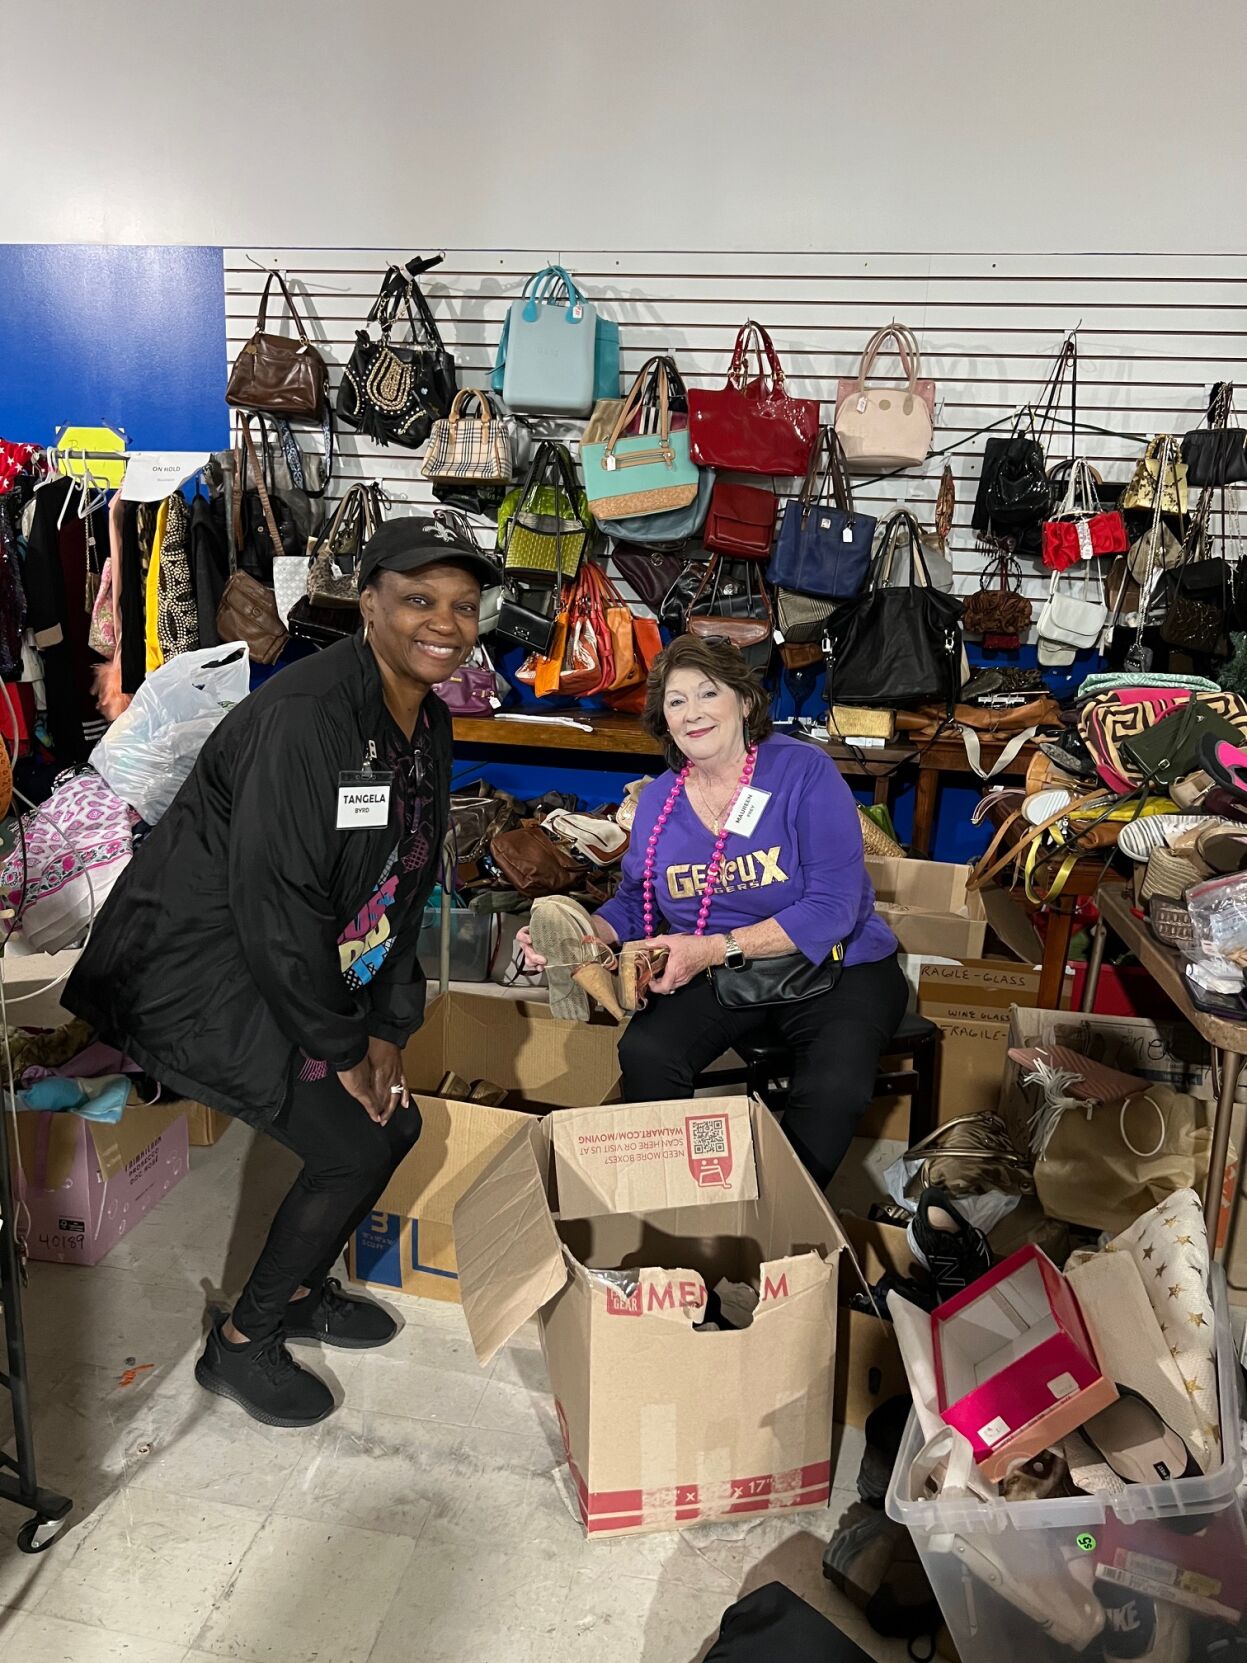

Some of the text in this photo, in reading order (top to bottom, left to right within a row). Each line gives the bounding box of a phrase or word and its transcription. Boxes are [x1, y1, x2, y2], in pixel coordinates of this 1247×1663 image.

[343, 794, 386, 805] TANGELA
[735, 793, 753, 824] MAUREEN
[667, 846, 789, 899] GEUX
[695, 880, 760, 896] TGERS
[947, 1009, 977, 1019] WINE
[578, 1127, 683, 1144] WALMART.COM/MOVING
[580, 1138, 684, 1156] SCAN HERE OR VISIT US AT
[604, 1149, 685, 1164] NEED MORE BOXES?
[39, 1233, 85, 1250] 40189
